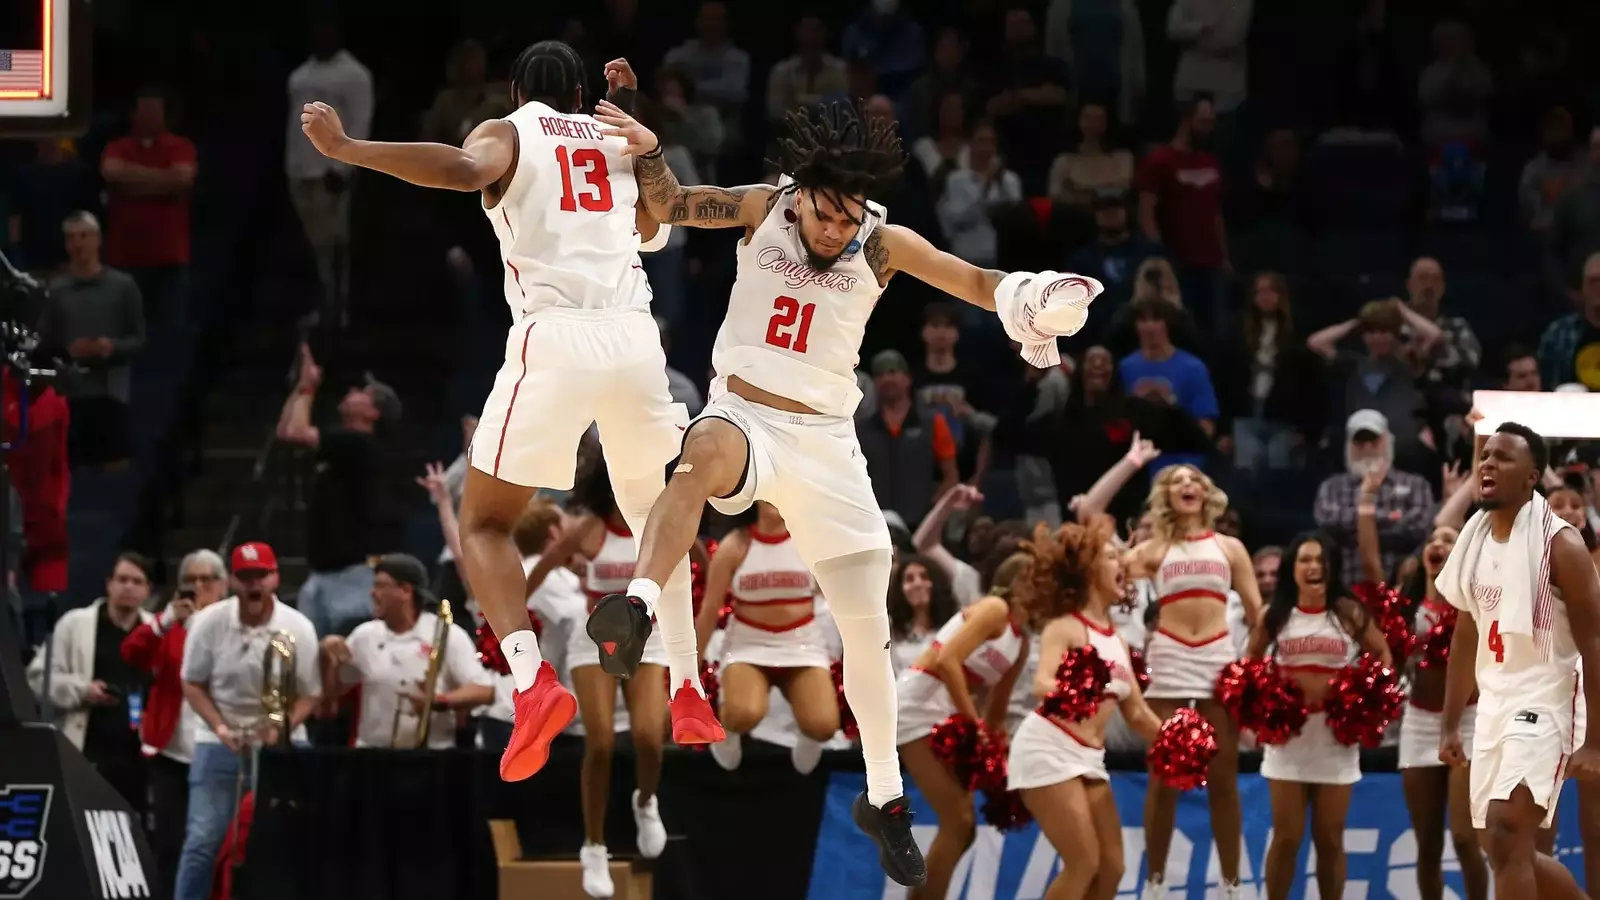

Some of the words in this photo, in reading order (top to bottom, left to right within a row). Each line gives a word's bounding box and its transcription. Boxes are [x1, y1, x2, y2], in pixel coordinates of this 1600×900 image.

[538, 116, 604, 140] ROBERTS
[555, 144, 614, 212] 13
[757, 246, 857, 292] Cougars
[765, 295, 816, 353] 21
[1488, 620, 1504, 662] 4
[84, 809, 150, 899] NCAA
